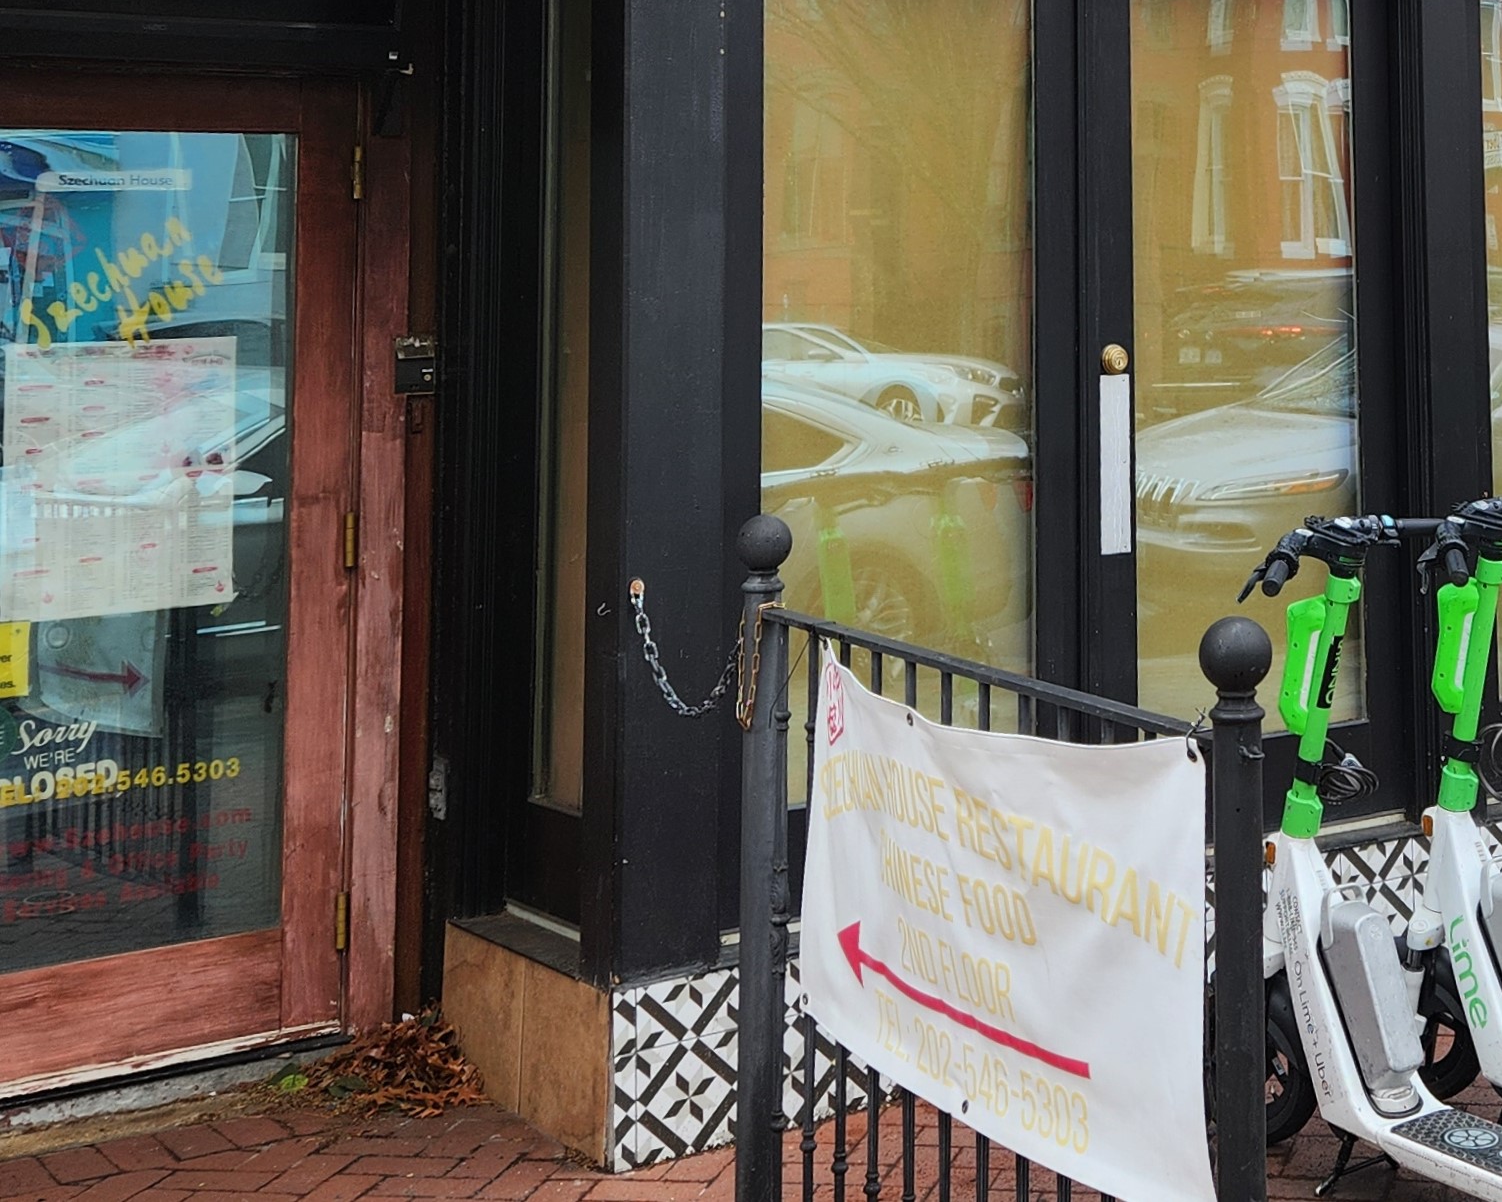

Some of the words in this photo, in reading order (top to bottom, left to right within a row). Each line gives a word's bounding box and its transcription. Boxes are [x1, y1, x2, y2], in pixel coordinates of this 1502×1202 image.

[57, 173, 126, 188] Szechuan
[129, 173, 174, 186] House
[118, 253, 225, 349] House
[10, 719, 97, 755] Sorry
[23, 747, 76, 770] WE'RE
[55, 757, 241, 799] 202.546.5303
[953, 785, 1197, 969] RESTAURANT
[957, 873, 1038, 946] FOOD
[897, 914, 938, 985] 2ND
[937, 938, 1016, 1023] FLOOR
[914, 1016, 1091, 1155] 202-546-5303
[1299, 989, 1315, 1036] Lime
[1314, 1051, 1333, 1098] Uber
